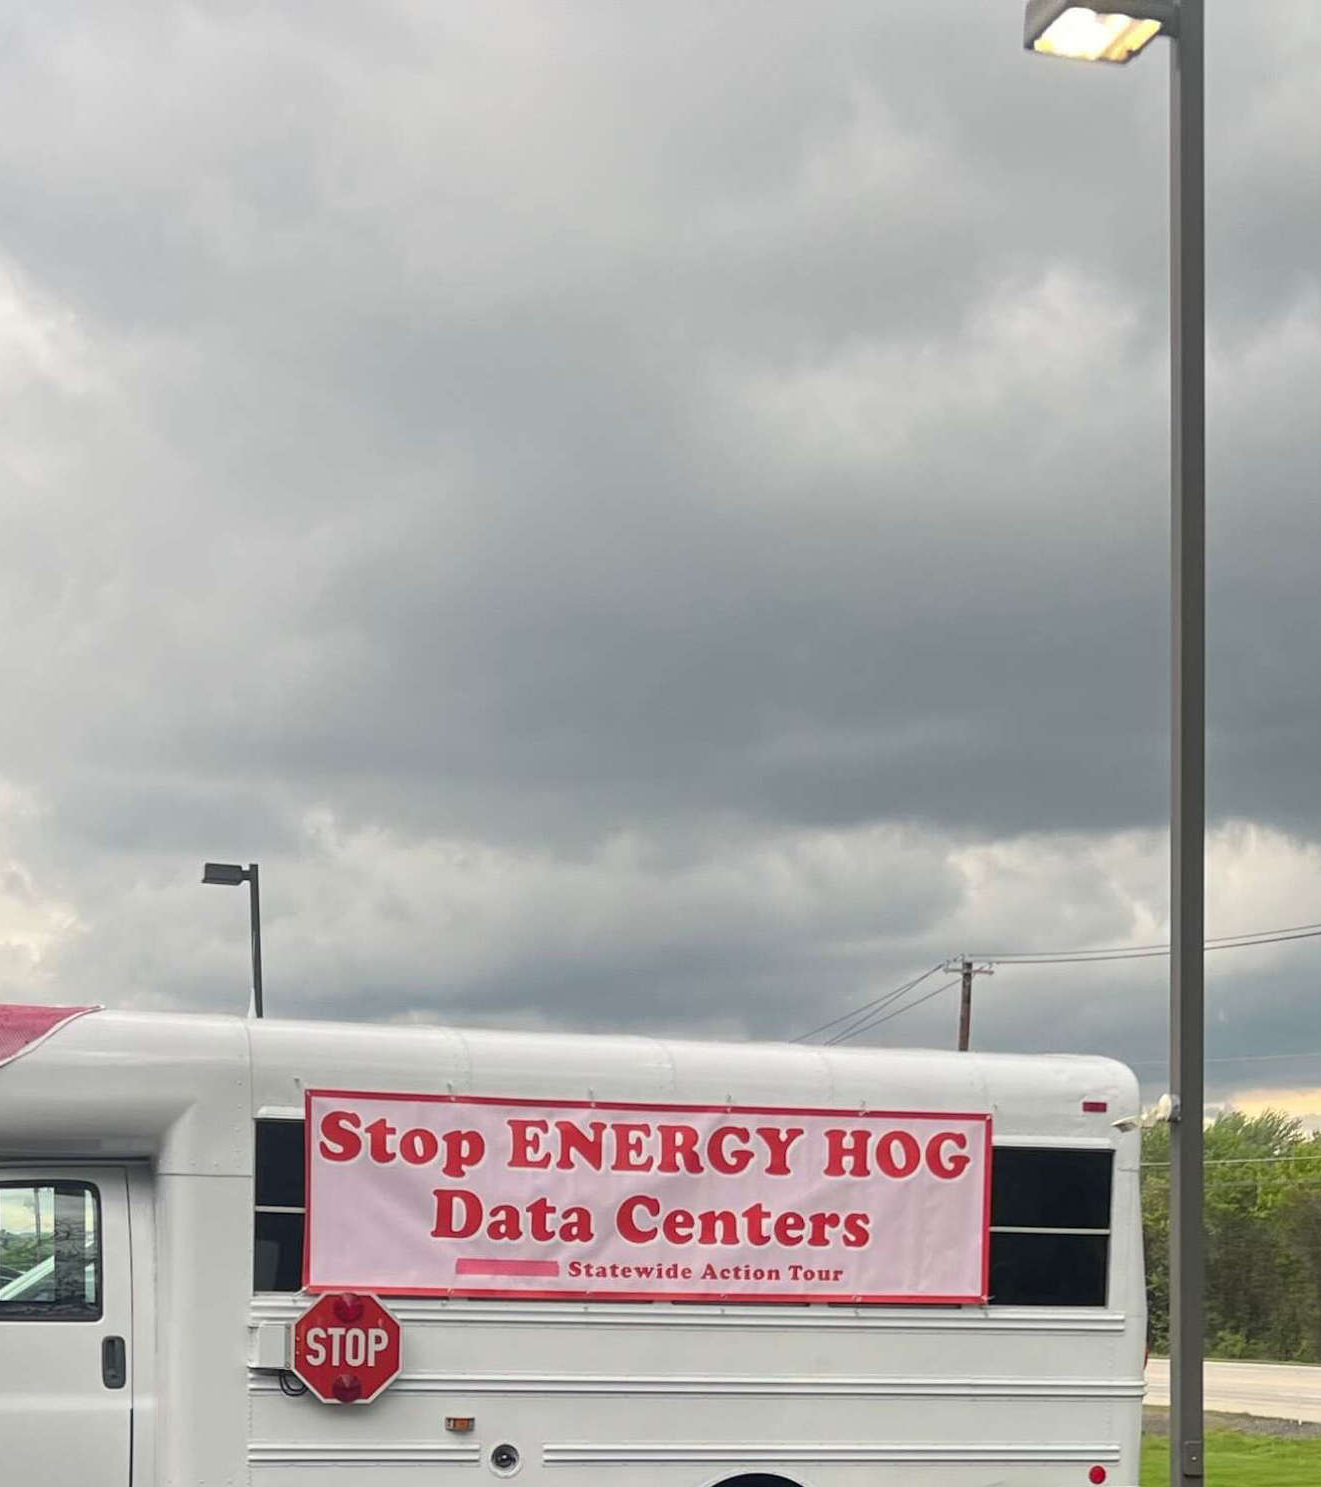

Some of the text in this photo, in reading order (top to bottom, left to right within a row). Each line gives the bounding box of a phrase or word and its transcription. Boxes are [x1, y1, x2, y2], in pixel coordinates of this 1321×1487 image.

[319, 1111, 971, 1180] Stop ENERGY HOG
[431, 1189, 871, 1249] Data Centers
[568, 1261, 844, 1281] Statewide Action Tour
[306, 1327, 389, 1367] STOP
